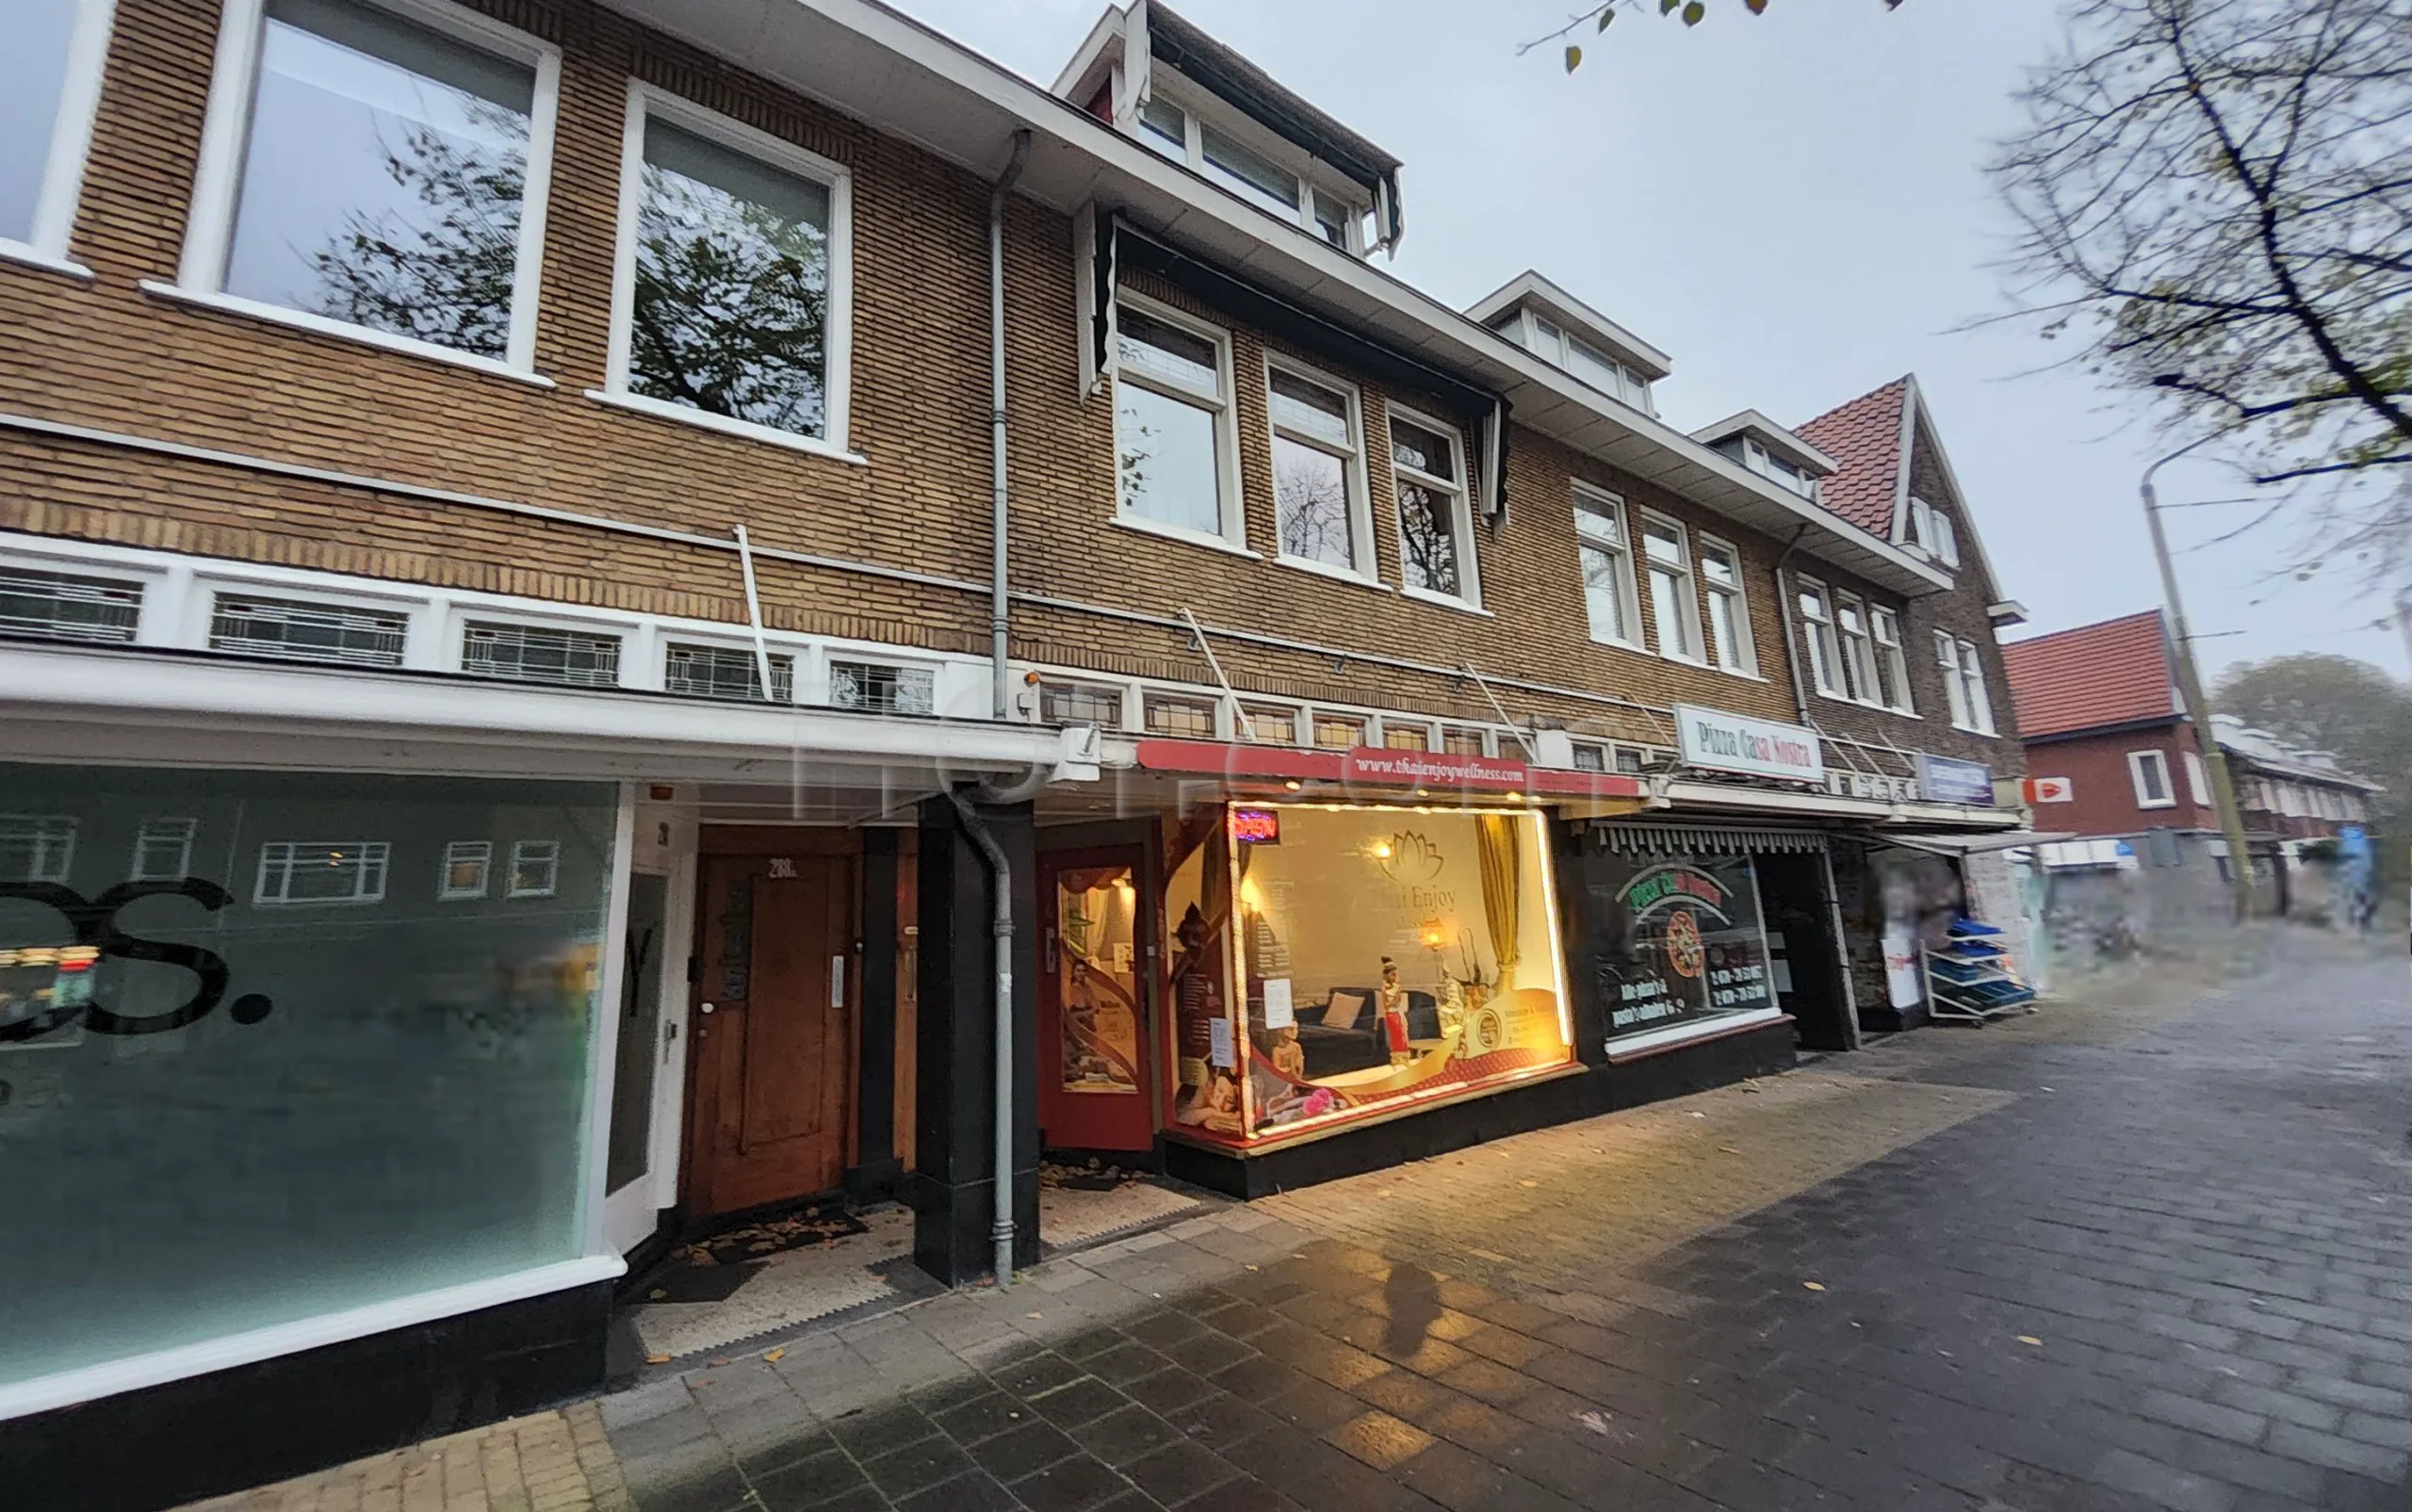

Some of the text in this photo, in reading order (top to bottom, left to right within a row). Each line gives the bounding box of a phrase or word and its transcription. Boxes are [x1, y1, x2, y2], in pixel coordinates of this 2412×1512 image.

[1695, 721, 1813, 768] Pizza Casa Nostra
[1355, 757, 1524, 782] www.thaienjoywellness.com
[1411, 886, 1457, 913] Enjoy
